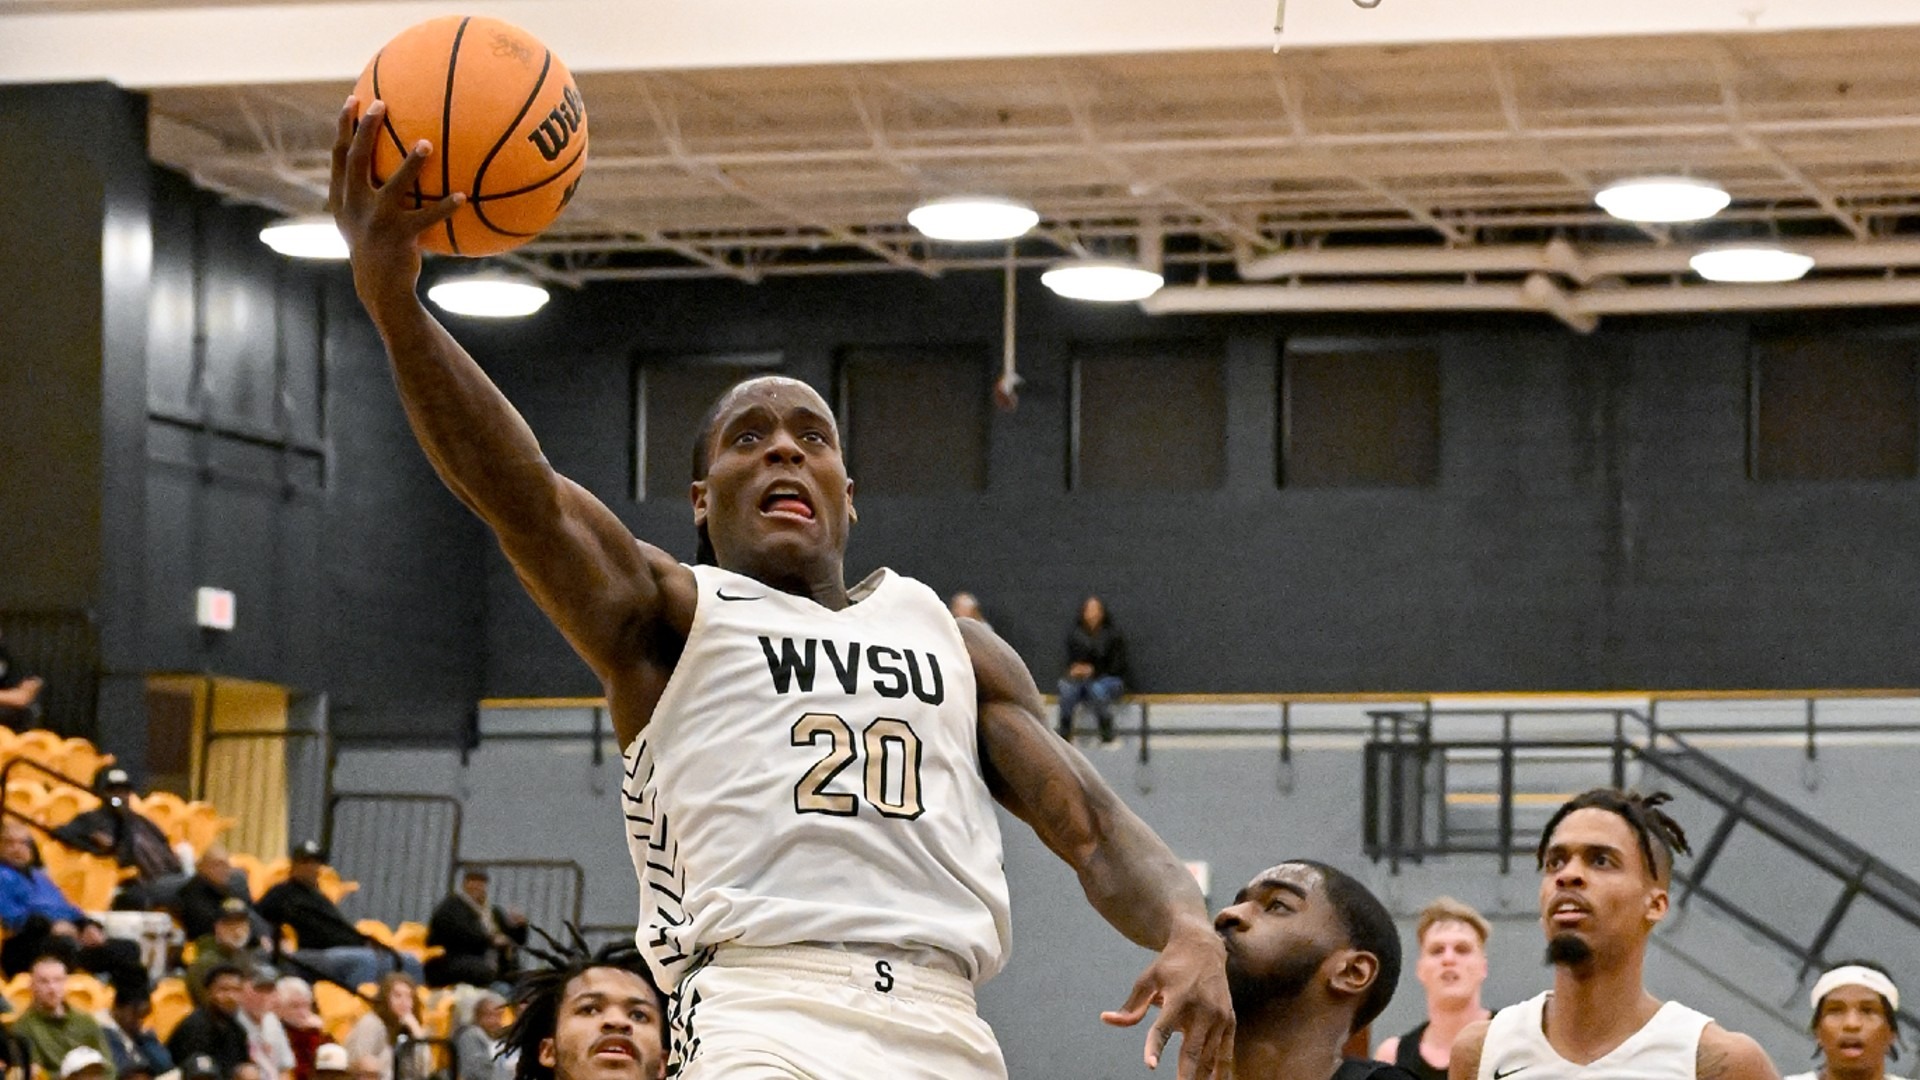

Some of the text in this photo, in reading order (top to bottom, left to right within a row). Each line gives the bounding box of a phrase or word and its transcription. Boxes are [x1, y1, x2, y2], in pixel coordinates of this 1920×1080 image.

[758, 635, 945, 706] WVSU
[791, 712, 926, 821] 20
[875, 960, 894, 993] S
